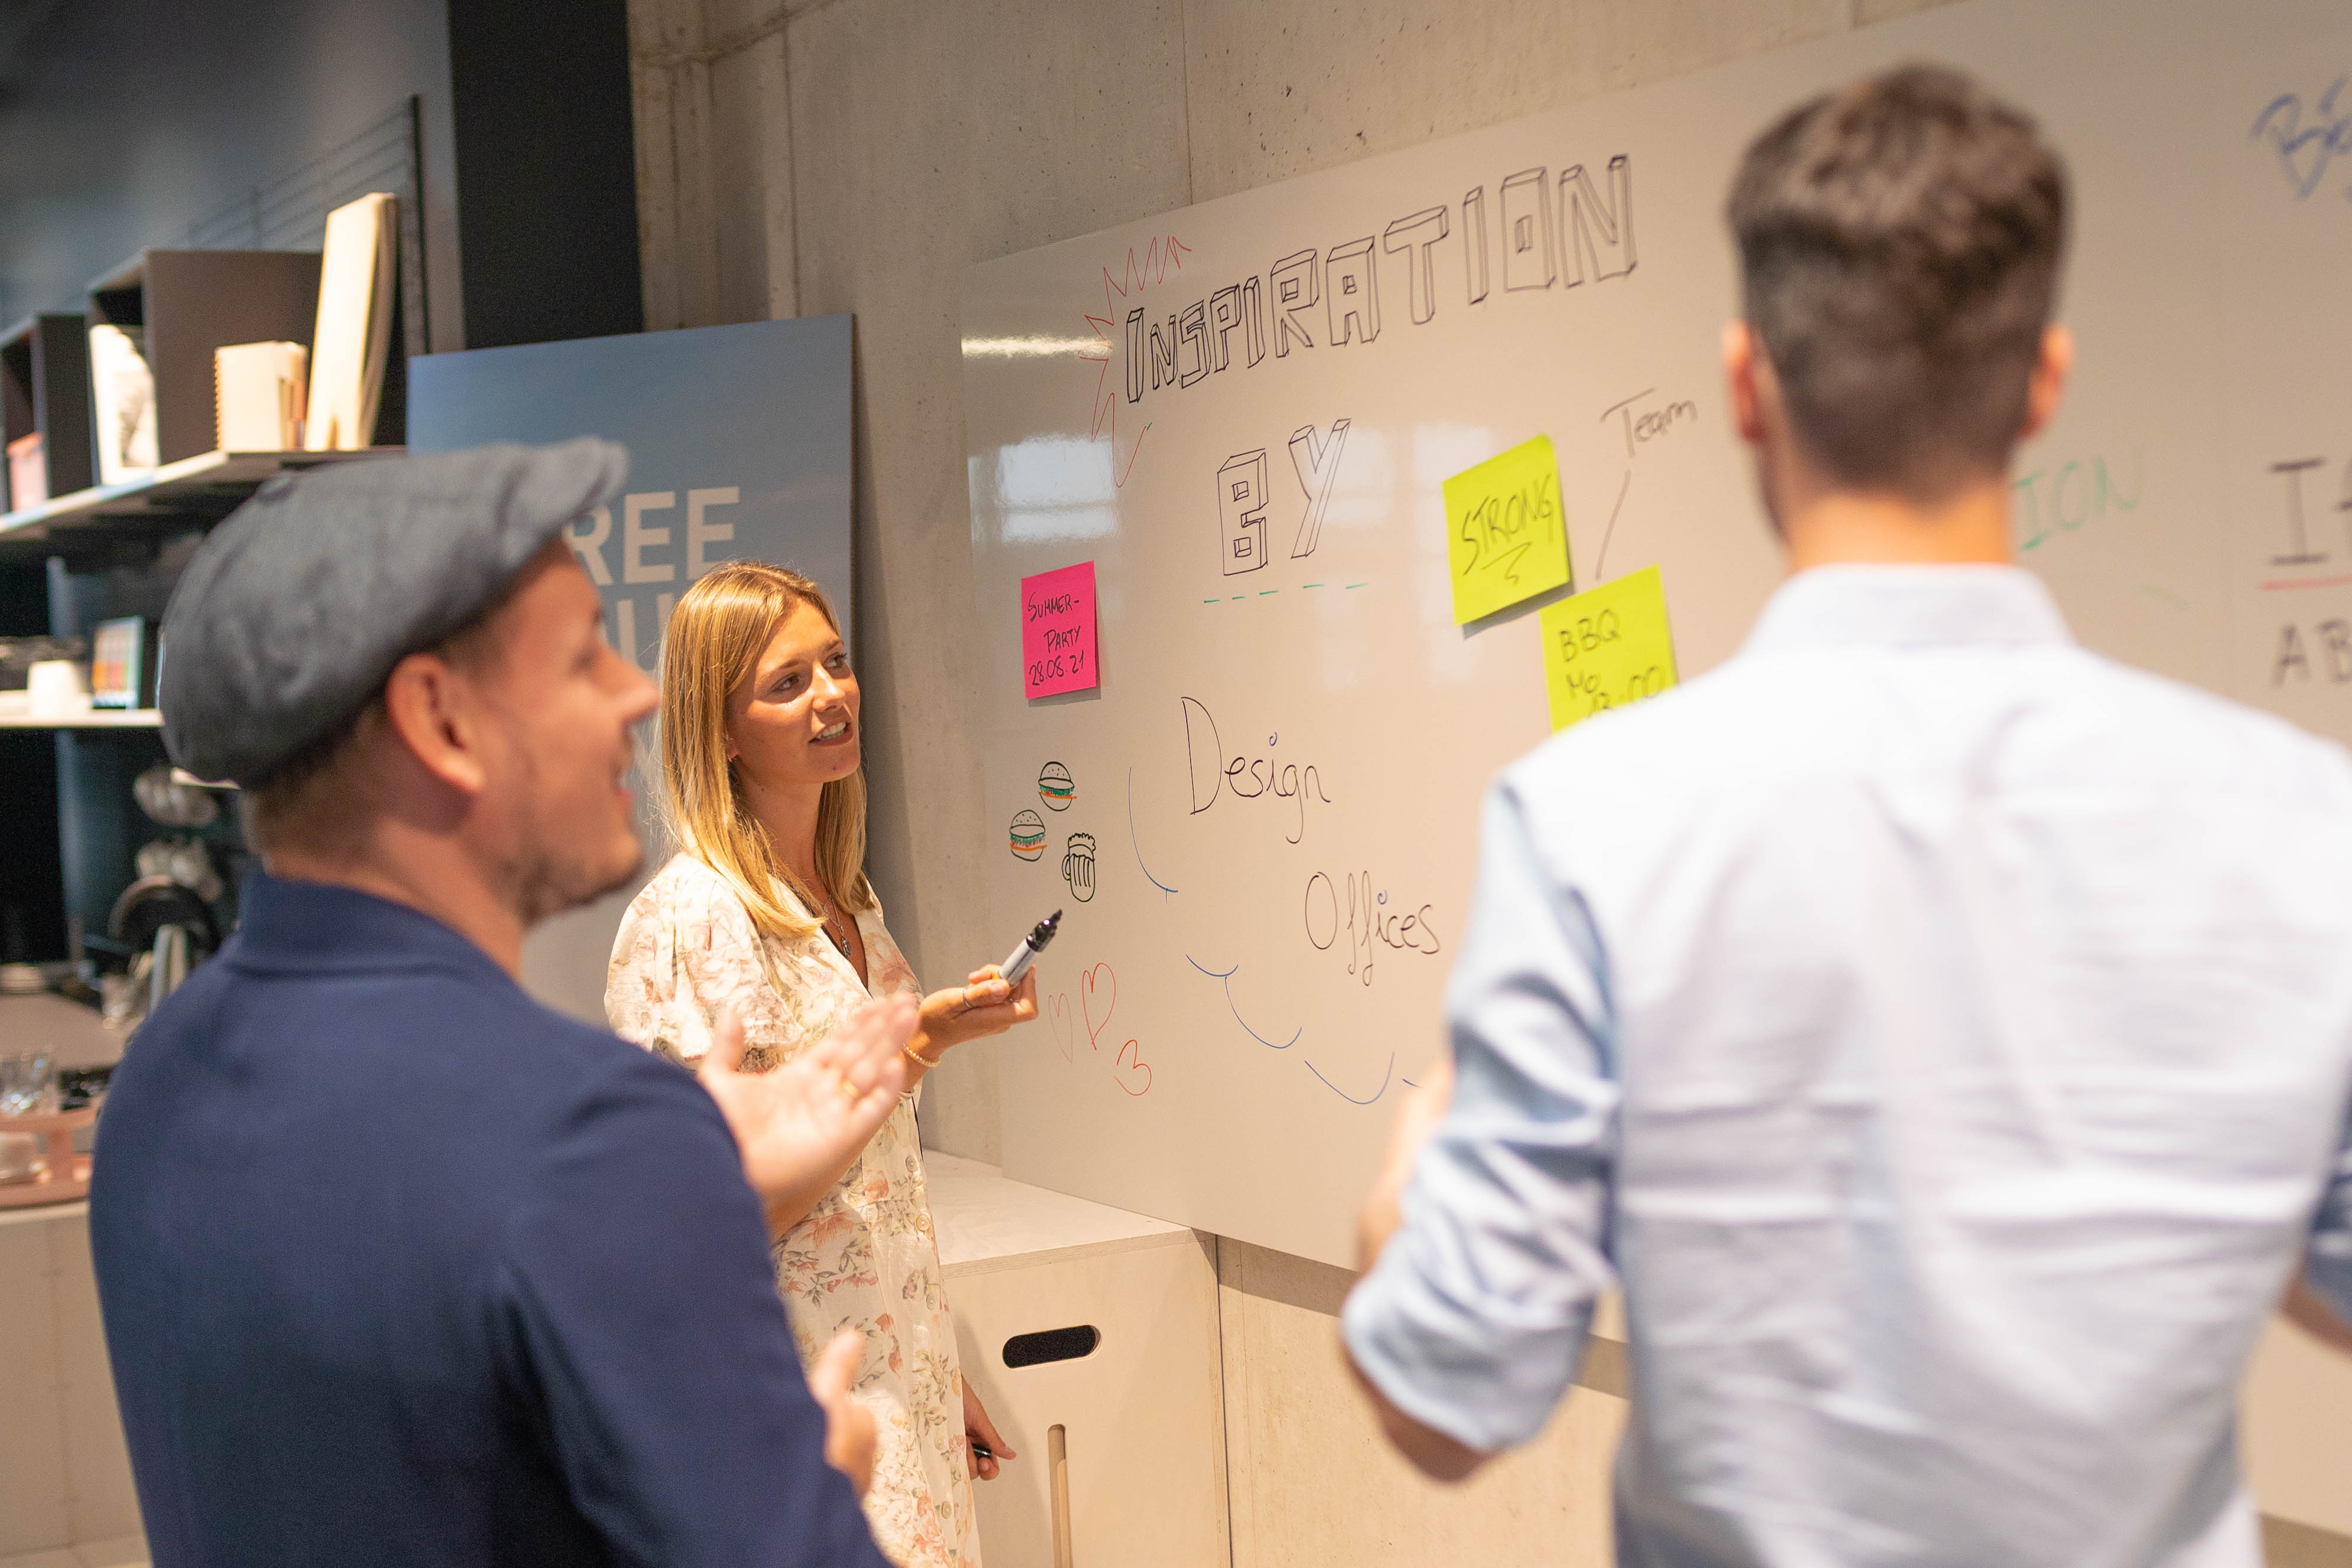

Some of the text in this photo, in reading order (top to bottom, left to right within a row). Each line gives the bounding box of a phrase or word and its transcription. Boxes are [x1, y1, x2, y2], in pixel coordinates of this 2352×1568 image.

[1600, 387, 1699, 457] Team
[1217, 418, 1351, 576] BY
[1461, 473, 1555, 576] STRONG
[1559, 608, 1622, 663] BBQ
[1180, 696, 1332, 844] Design
[1304, 870, 1441, 987] Offices
